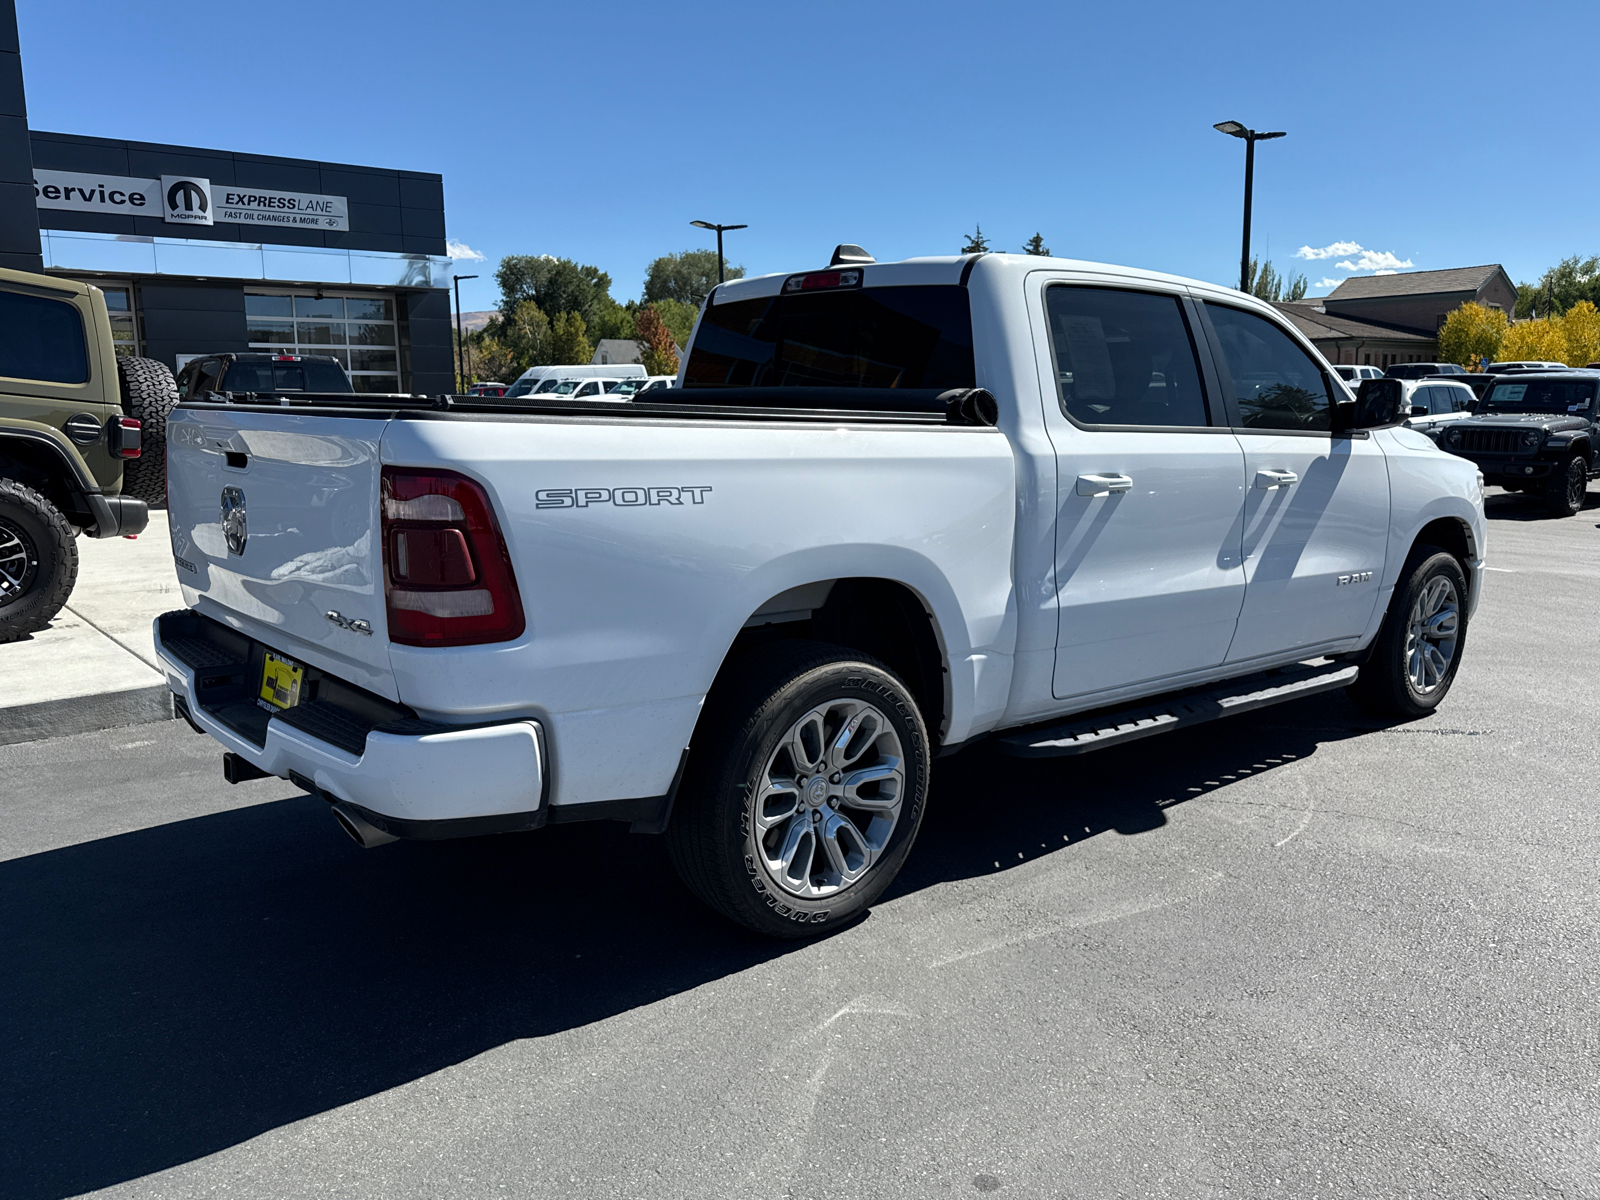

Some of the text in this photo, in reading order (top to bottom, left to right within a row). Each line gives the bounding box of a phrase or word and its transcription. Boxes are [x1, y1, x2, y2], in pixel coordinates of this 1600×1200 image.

[171, 213, 208, 221] MOPAR
[224, 211, 320, 226] FAST OIL CHANGES & MORE
[535, 486, 713, 509] SPORT
[1336, 571, 1373, 587] RAM
[743, 854, 831, 924] DUELER
